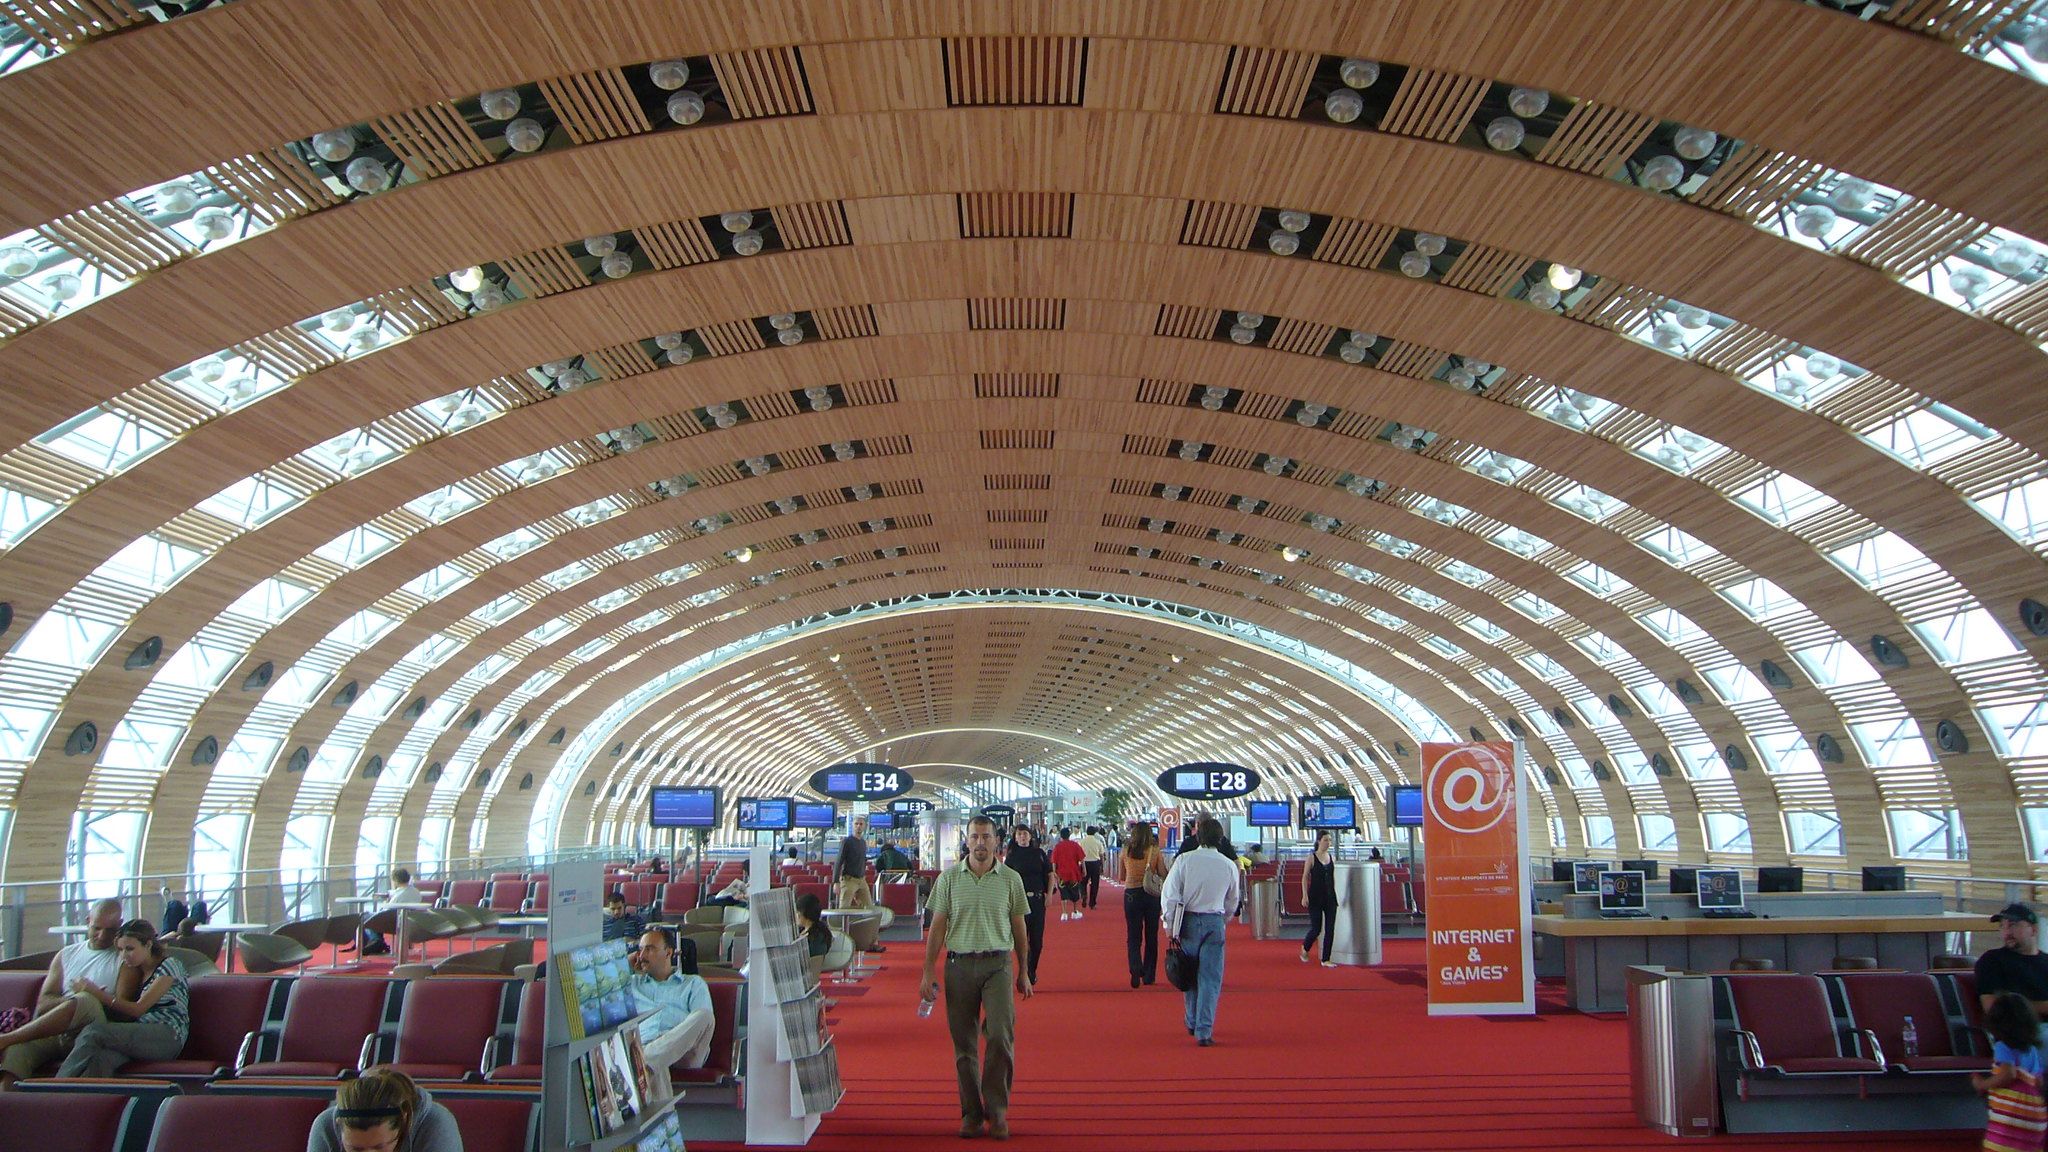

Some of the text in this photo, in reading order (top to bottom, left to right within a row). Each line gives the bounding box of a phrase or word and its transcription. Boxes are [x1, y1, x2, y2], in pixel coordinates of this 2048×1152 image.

[862, 773, 899, 792] E34
[1209, 772, 1247, 791] E28
[1427, 747, 1510, 833] @
[909, 802, 927, 811] E35
[1432, 929, 1515, 945] INTERNET
[1467, 946, 1481, 962] &
